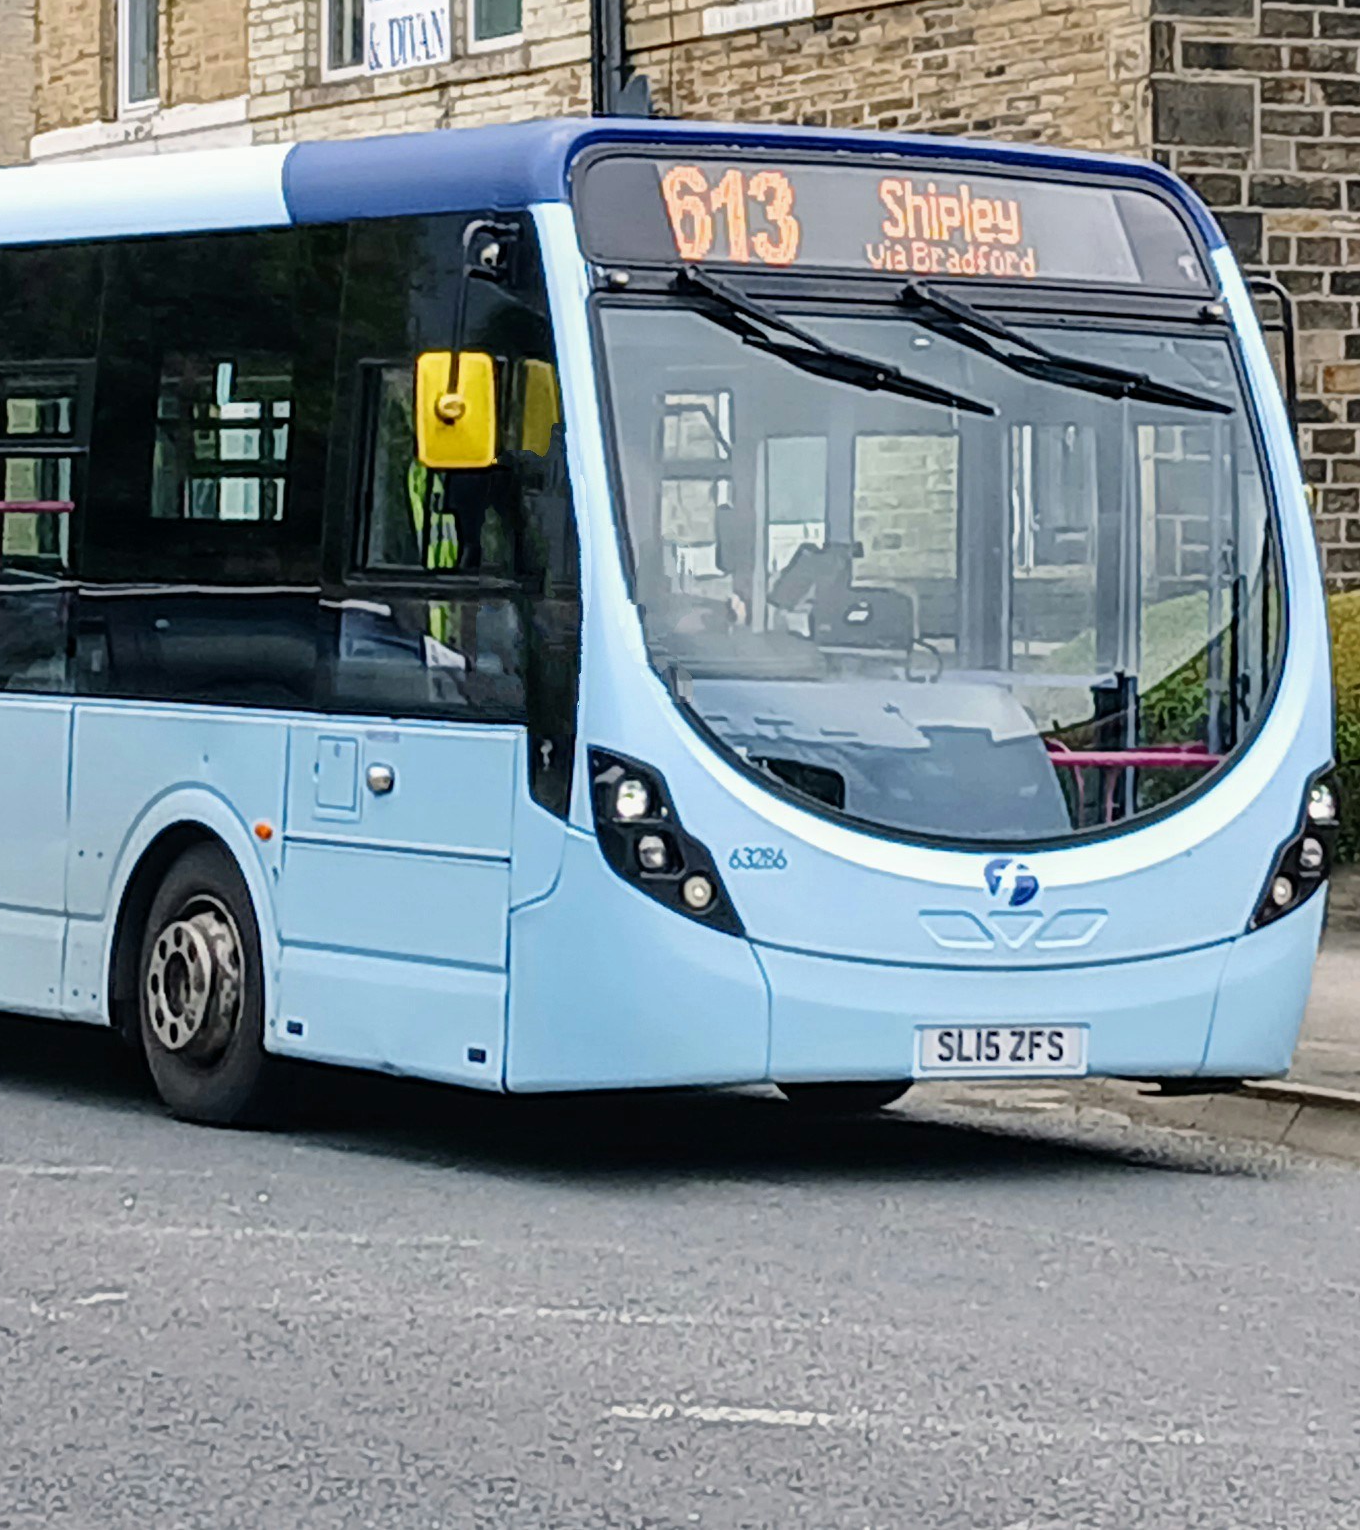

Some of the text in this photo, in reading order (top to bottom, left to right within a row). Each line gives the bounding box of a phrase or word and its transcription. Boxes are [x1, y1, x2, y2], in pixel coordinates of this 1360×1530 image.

[663, 166, 1023, 267] 613 Shipley
[865, 241, 1037, 277] via Bradford
[728, 846, 789, 870] 63286
[937, 1029, 1065, 1062] SL15 ZFS
